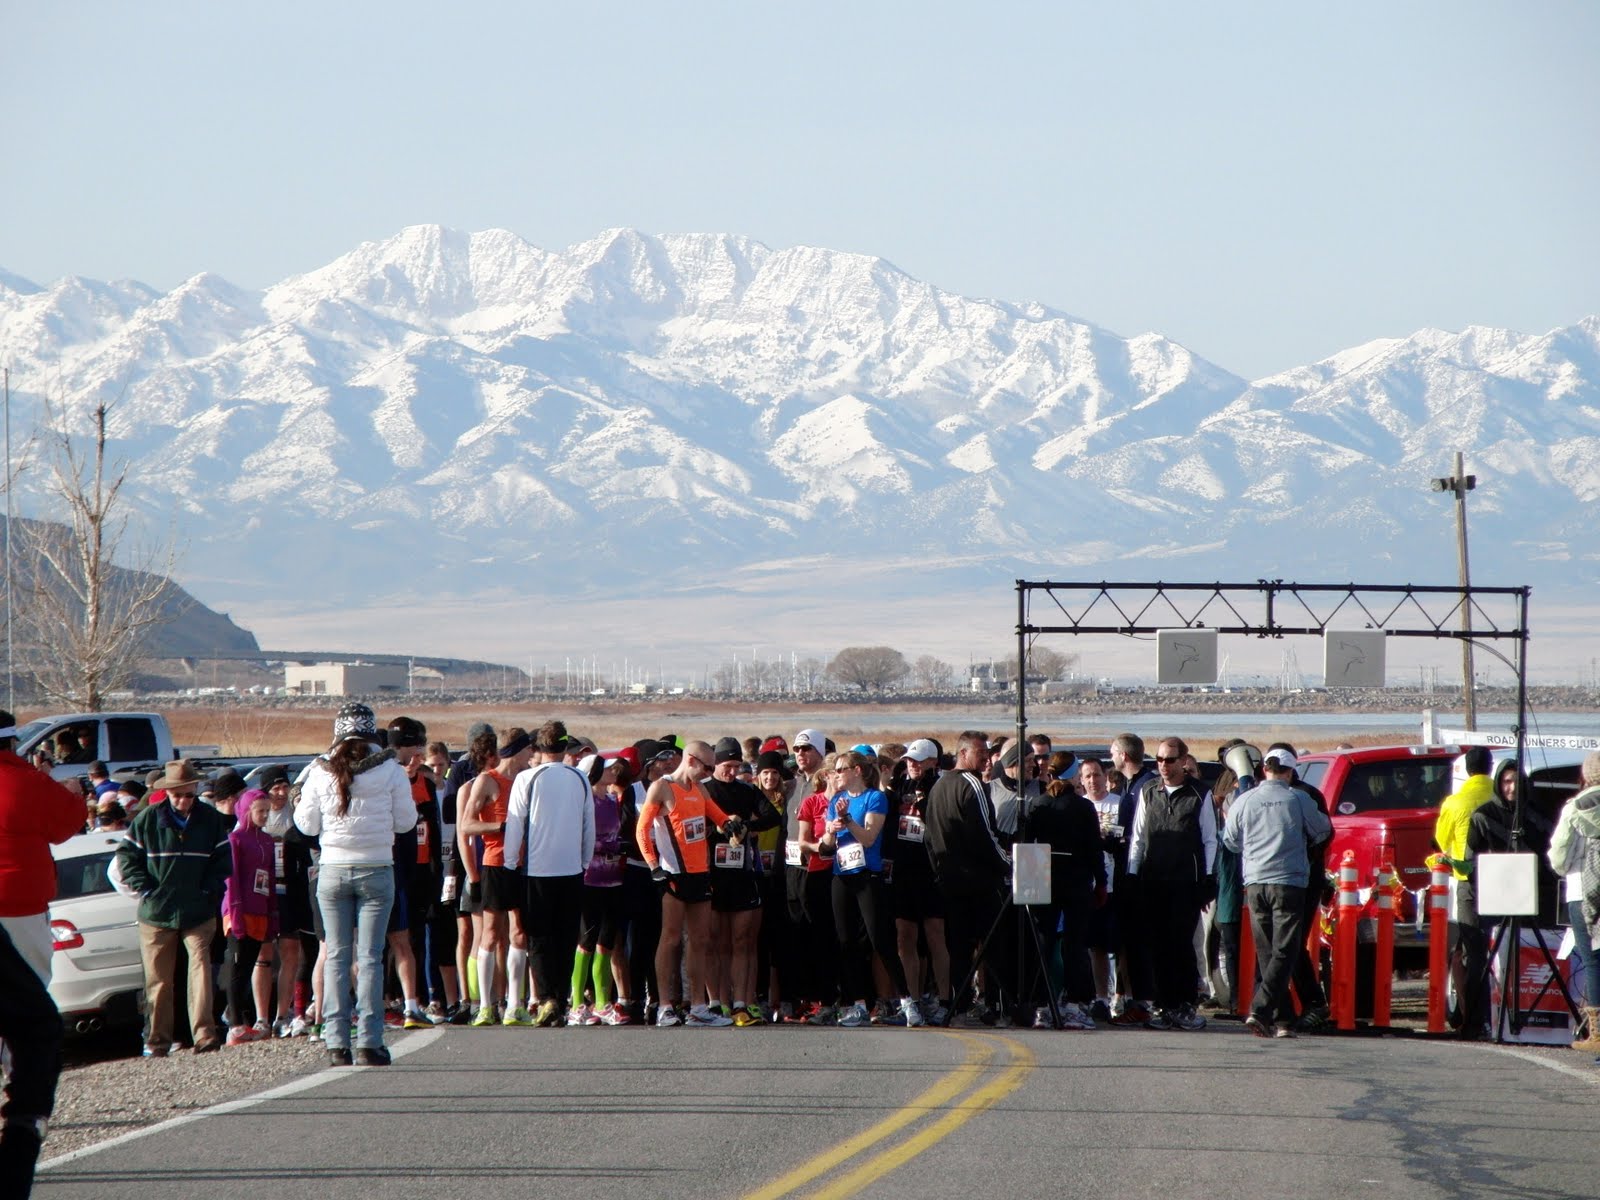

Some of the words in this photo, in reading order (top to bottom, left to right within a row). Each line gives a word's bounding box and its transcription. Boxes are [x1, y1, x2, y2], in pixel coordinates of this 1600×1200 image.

[1487, 735, 1515, 745] ROAD
[1522, 738, 1566, 748] UNNERS
[1569, 739, 1598, 749] CLUB
[729, 851, 741, 861] 314
[849, 850, 861, 861] 322
